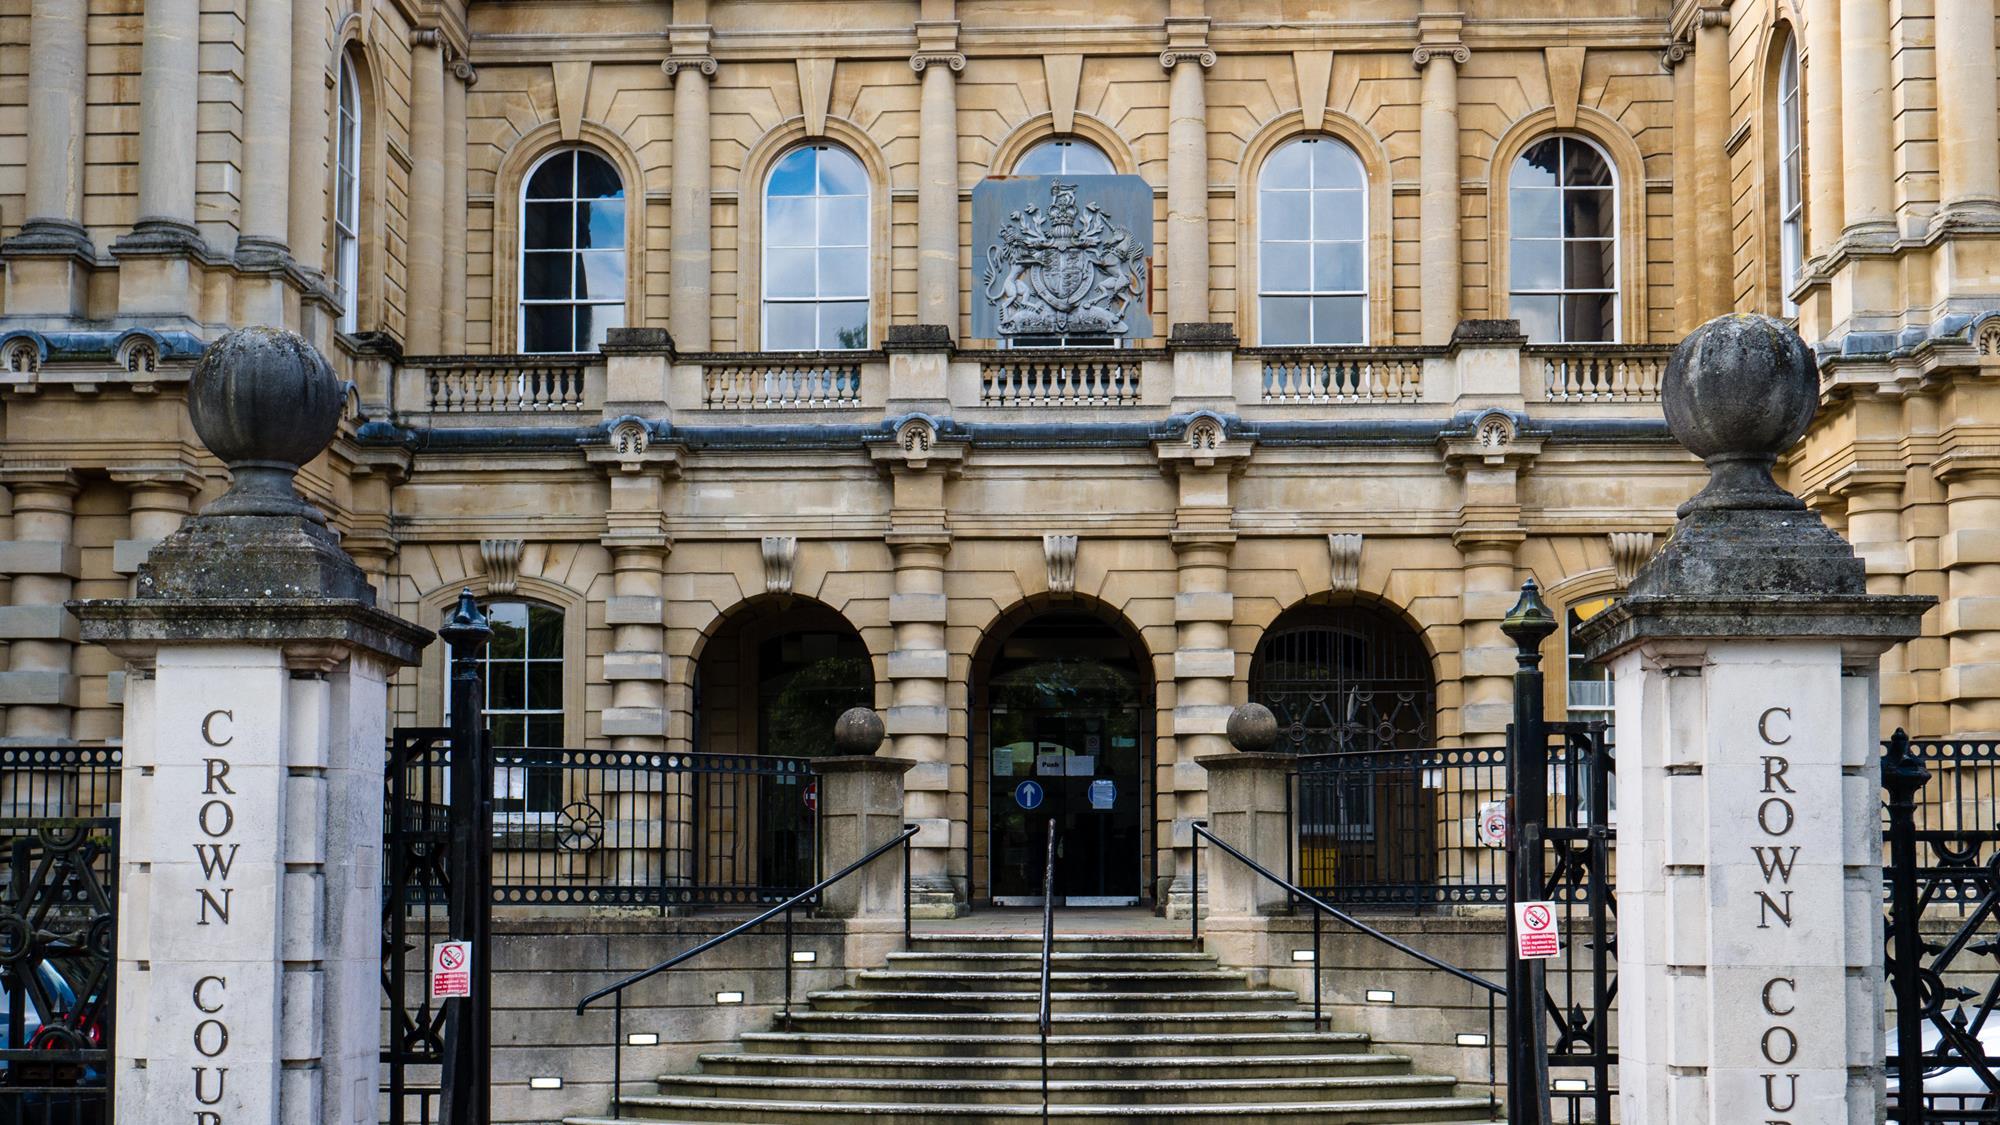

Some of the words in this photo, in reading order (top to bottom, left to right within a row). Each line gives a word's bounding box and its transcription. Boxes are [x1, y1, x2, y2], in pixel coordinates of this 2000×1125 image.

[192, 709, 240, 925] CROWN
[1750, 706, 1801, 929] CROWN
[1760, 976, 1800, 1125] COU
